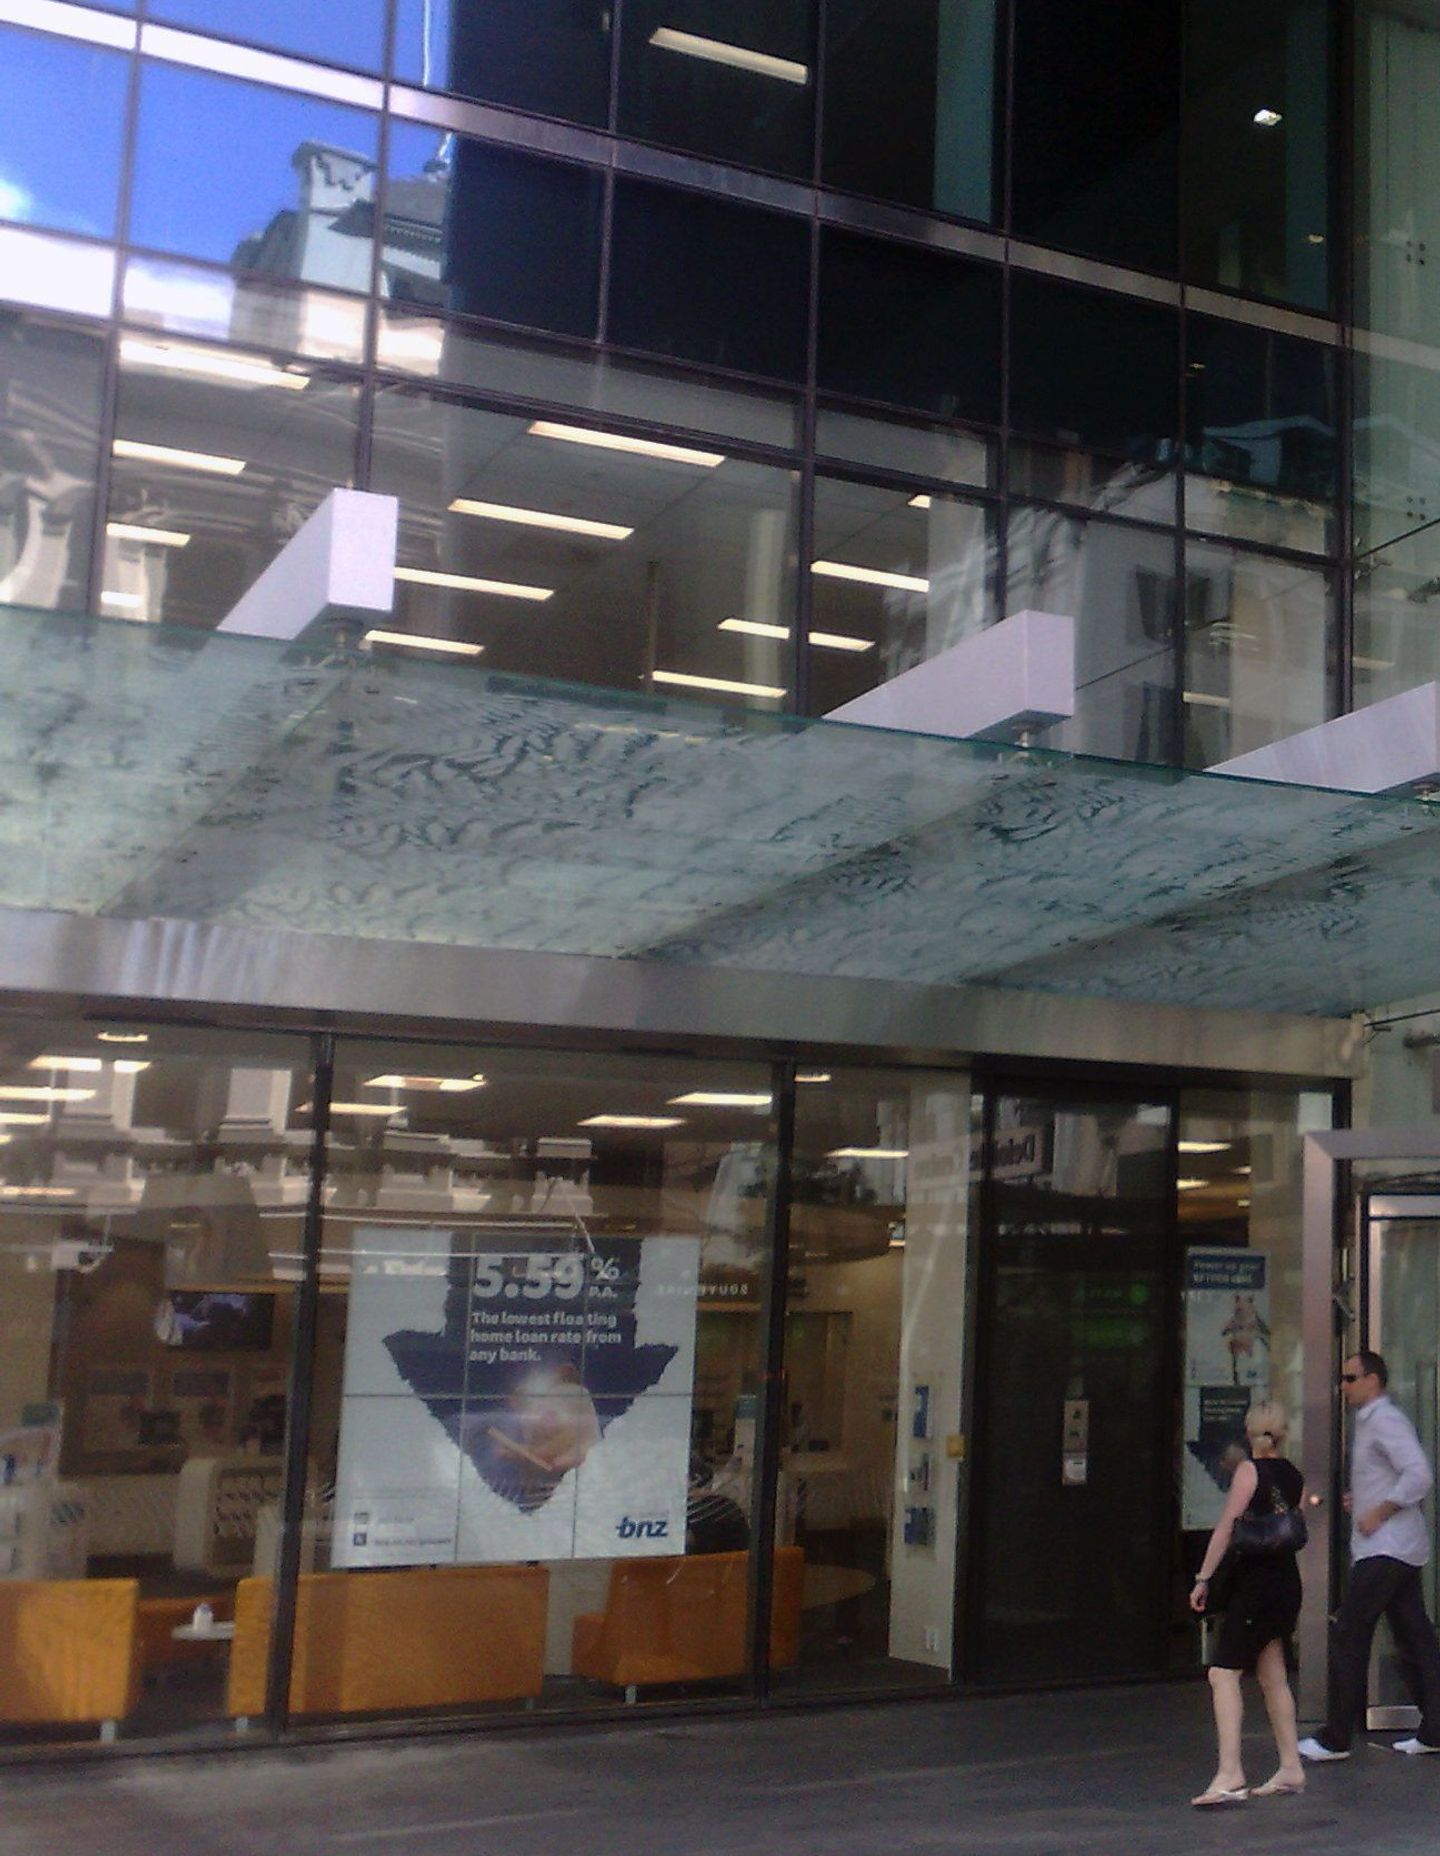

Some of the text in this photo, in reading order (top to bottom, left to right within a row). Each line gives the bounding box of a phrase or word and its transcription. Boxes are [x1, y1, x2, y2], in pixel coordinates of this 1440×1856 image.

[472, 1312, 499, 1325] The
[502, 1311, 550, 1325] lowest
[470, 1329, 622, 1343] home loan rate from
[469, 1348, 541, 1364] any bank.
[616, 1517, 668, 1538] bnz
